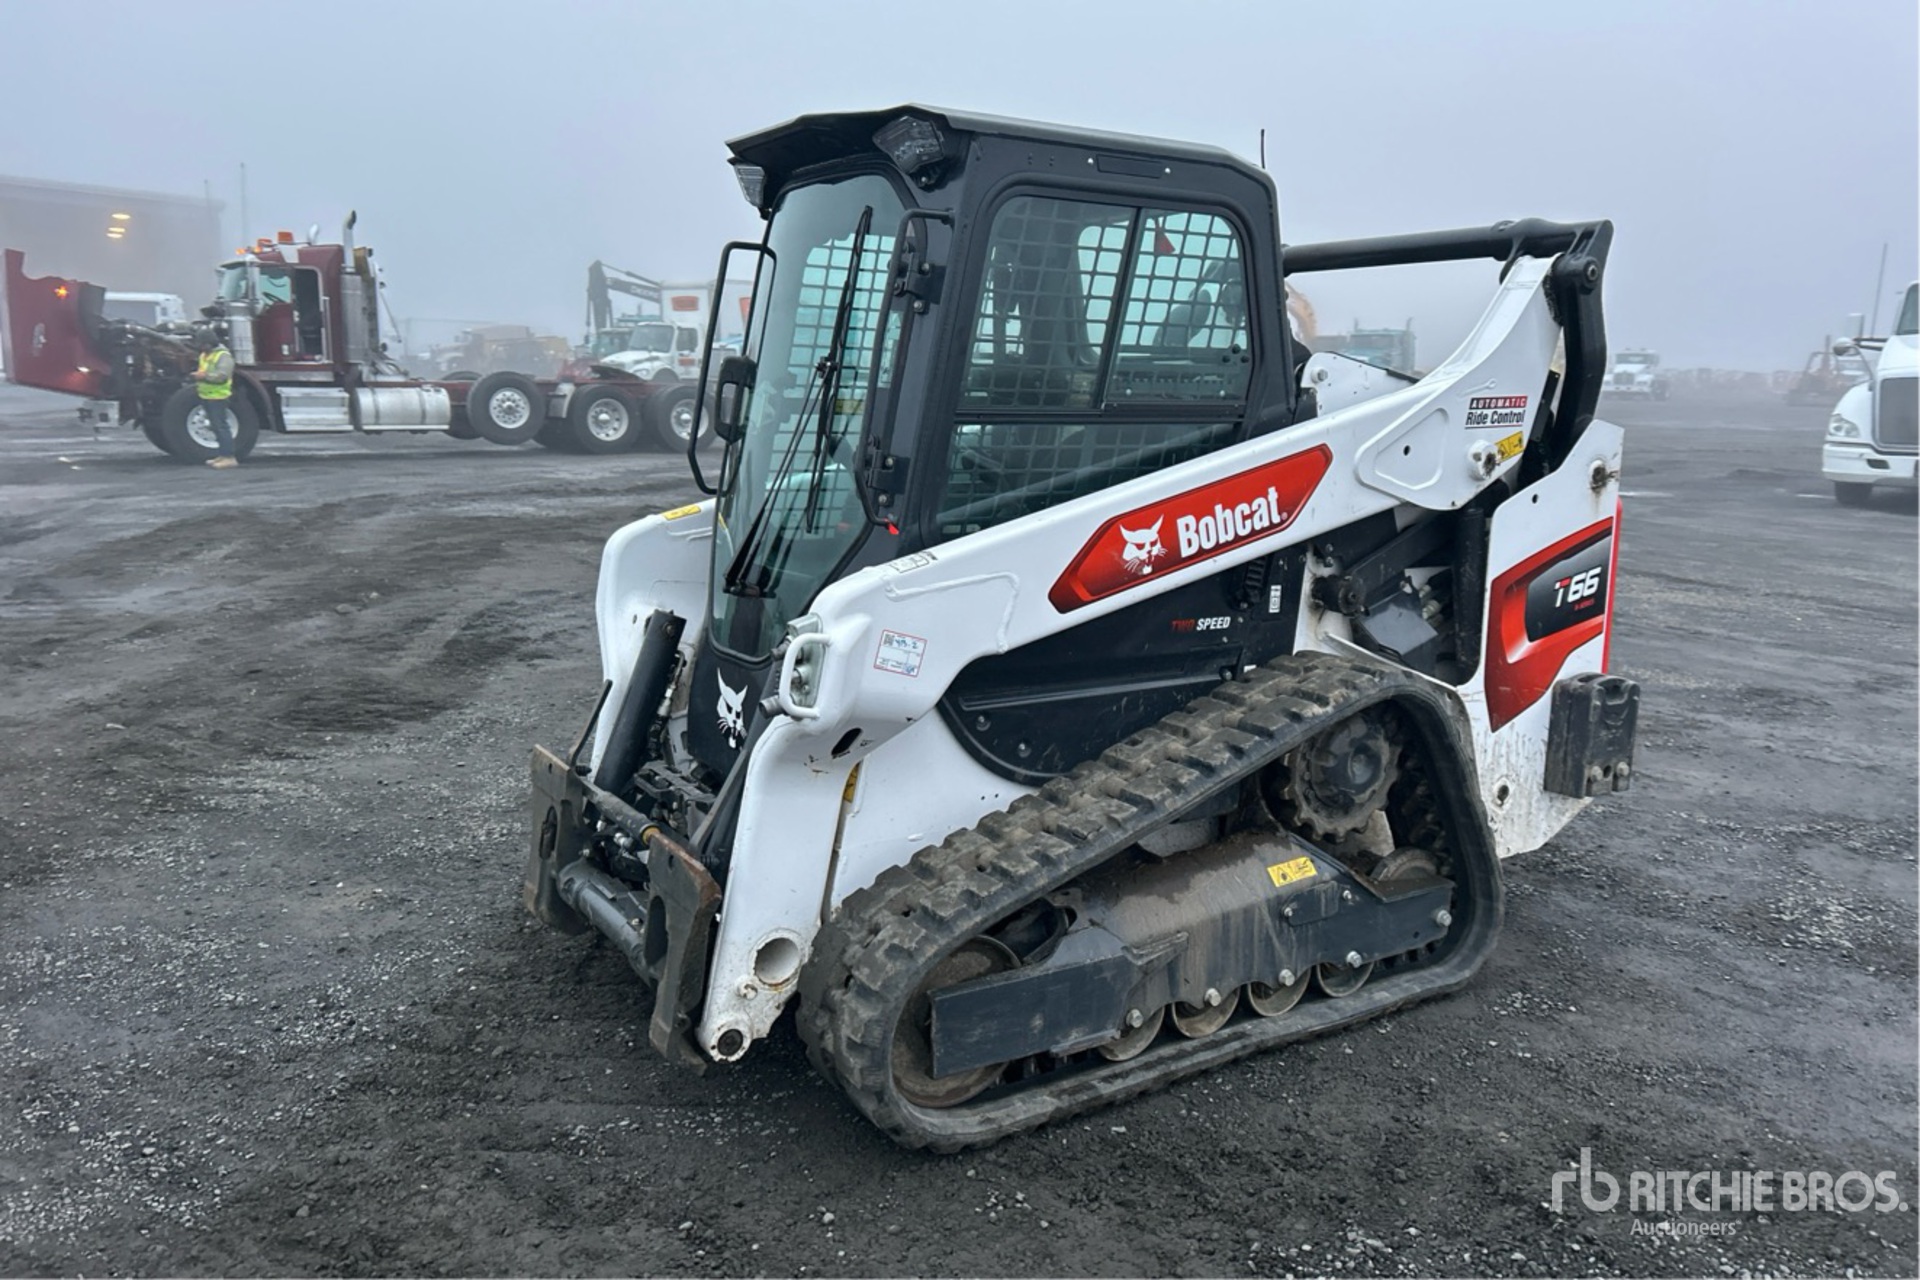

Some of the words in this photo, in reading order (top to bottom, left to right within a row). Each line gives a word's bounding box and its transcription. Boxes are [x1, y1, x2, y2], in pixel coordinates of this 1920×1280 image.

[1471, 397, 1526, 409] AUTOMATIC
[1465, 411, 1488, 425] Ride
[1490, 410, 1525, 424] Control
[1176, 486, 1281, 558] Bobcat
[1554, 566, 1602, 608] T66
[1196, 616, 1231, 630] SPEED
